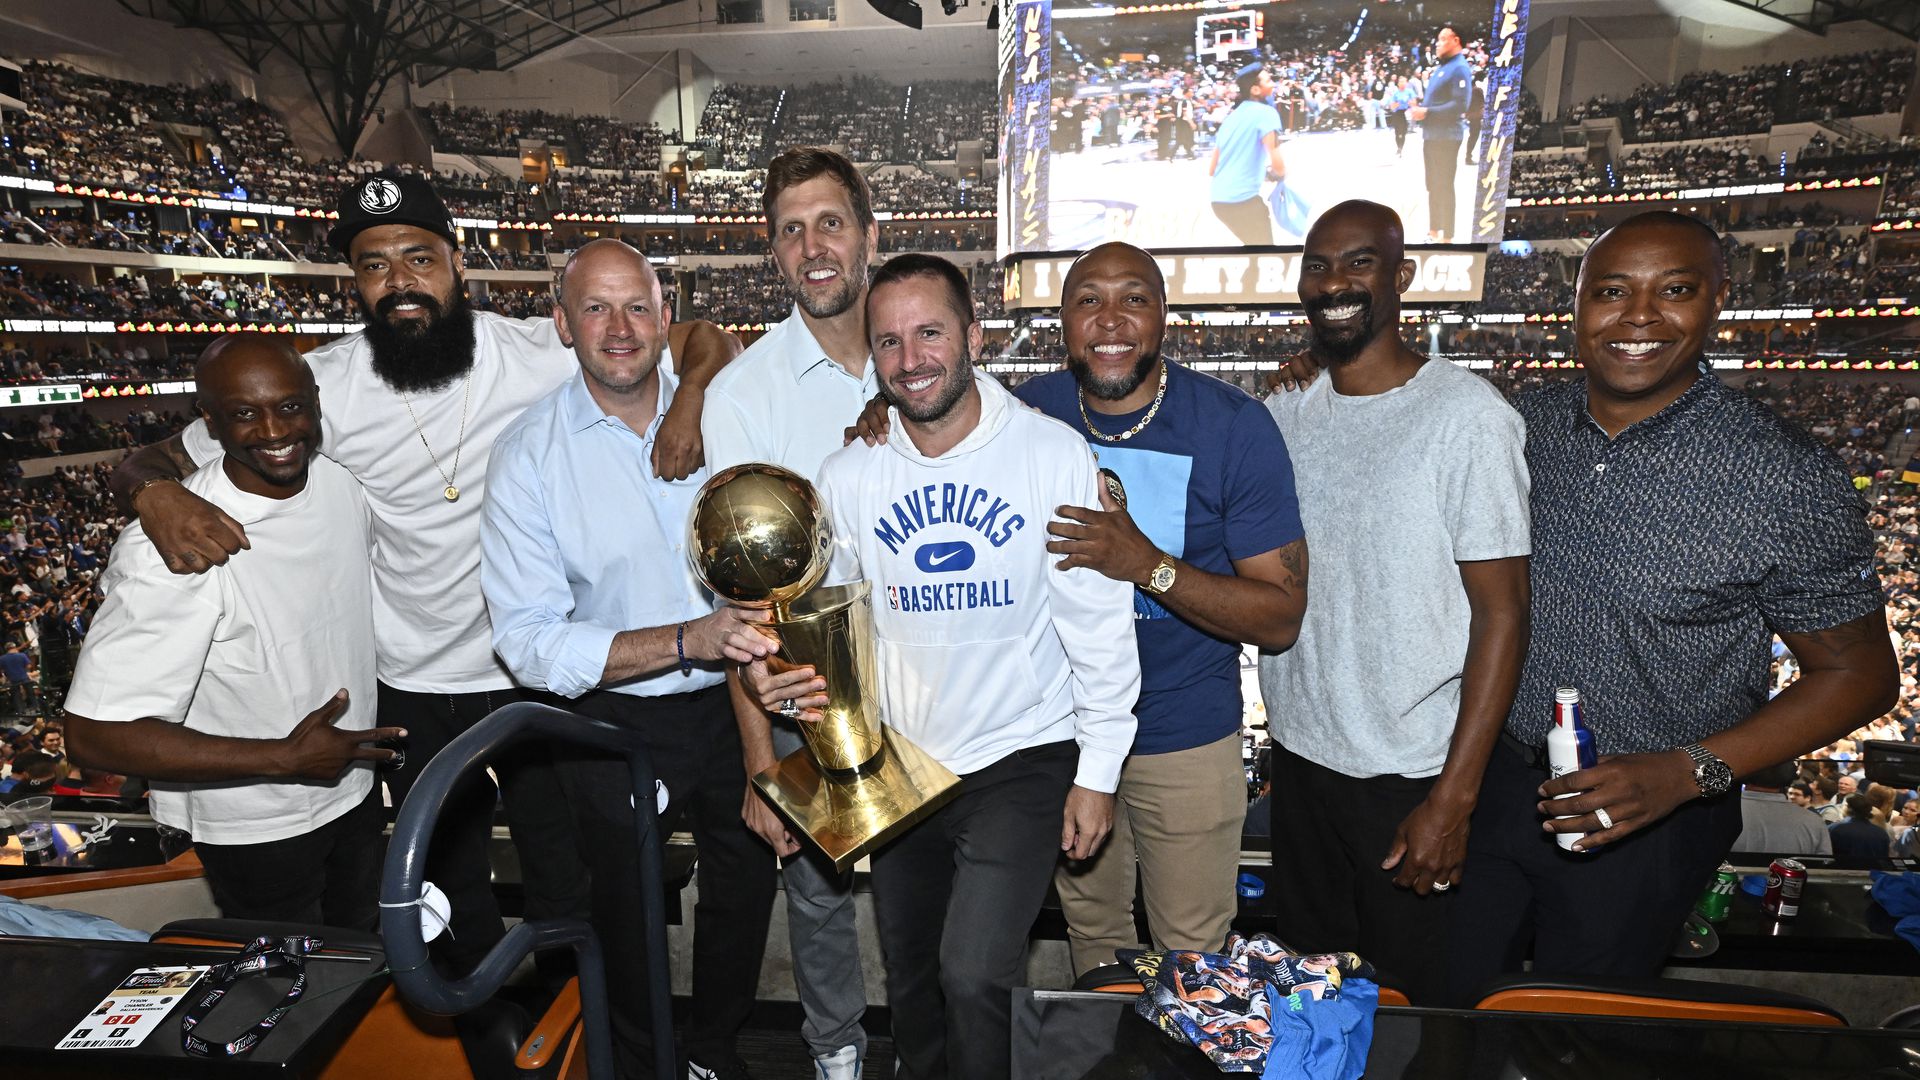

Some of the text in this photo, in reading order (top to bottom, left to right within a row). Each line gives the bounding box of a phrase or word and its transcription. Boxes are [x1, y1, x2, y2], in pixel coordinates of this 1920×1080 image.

[1020, 3, 1042, 246] NBA FINALS
[1479, 86, 1512, 236] FINALS
[1183, 256, 1251, 295] MY
[1403, 254, 1474, 292] ACK
[874, 483, 1026, 556] MAVERICKS
[899, 579, 1015, 613] BASKETBALL
